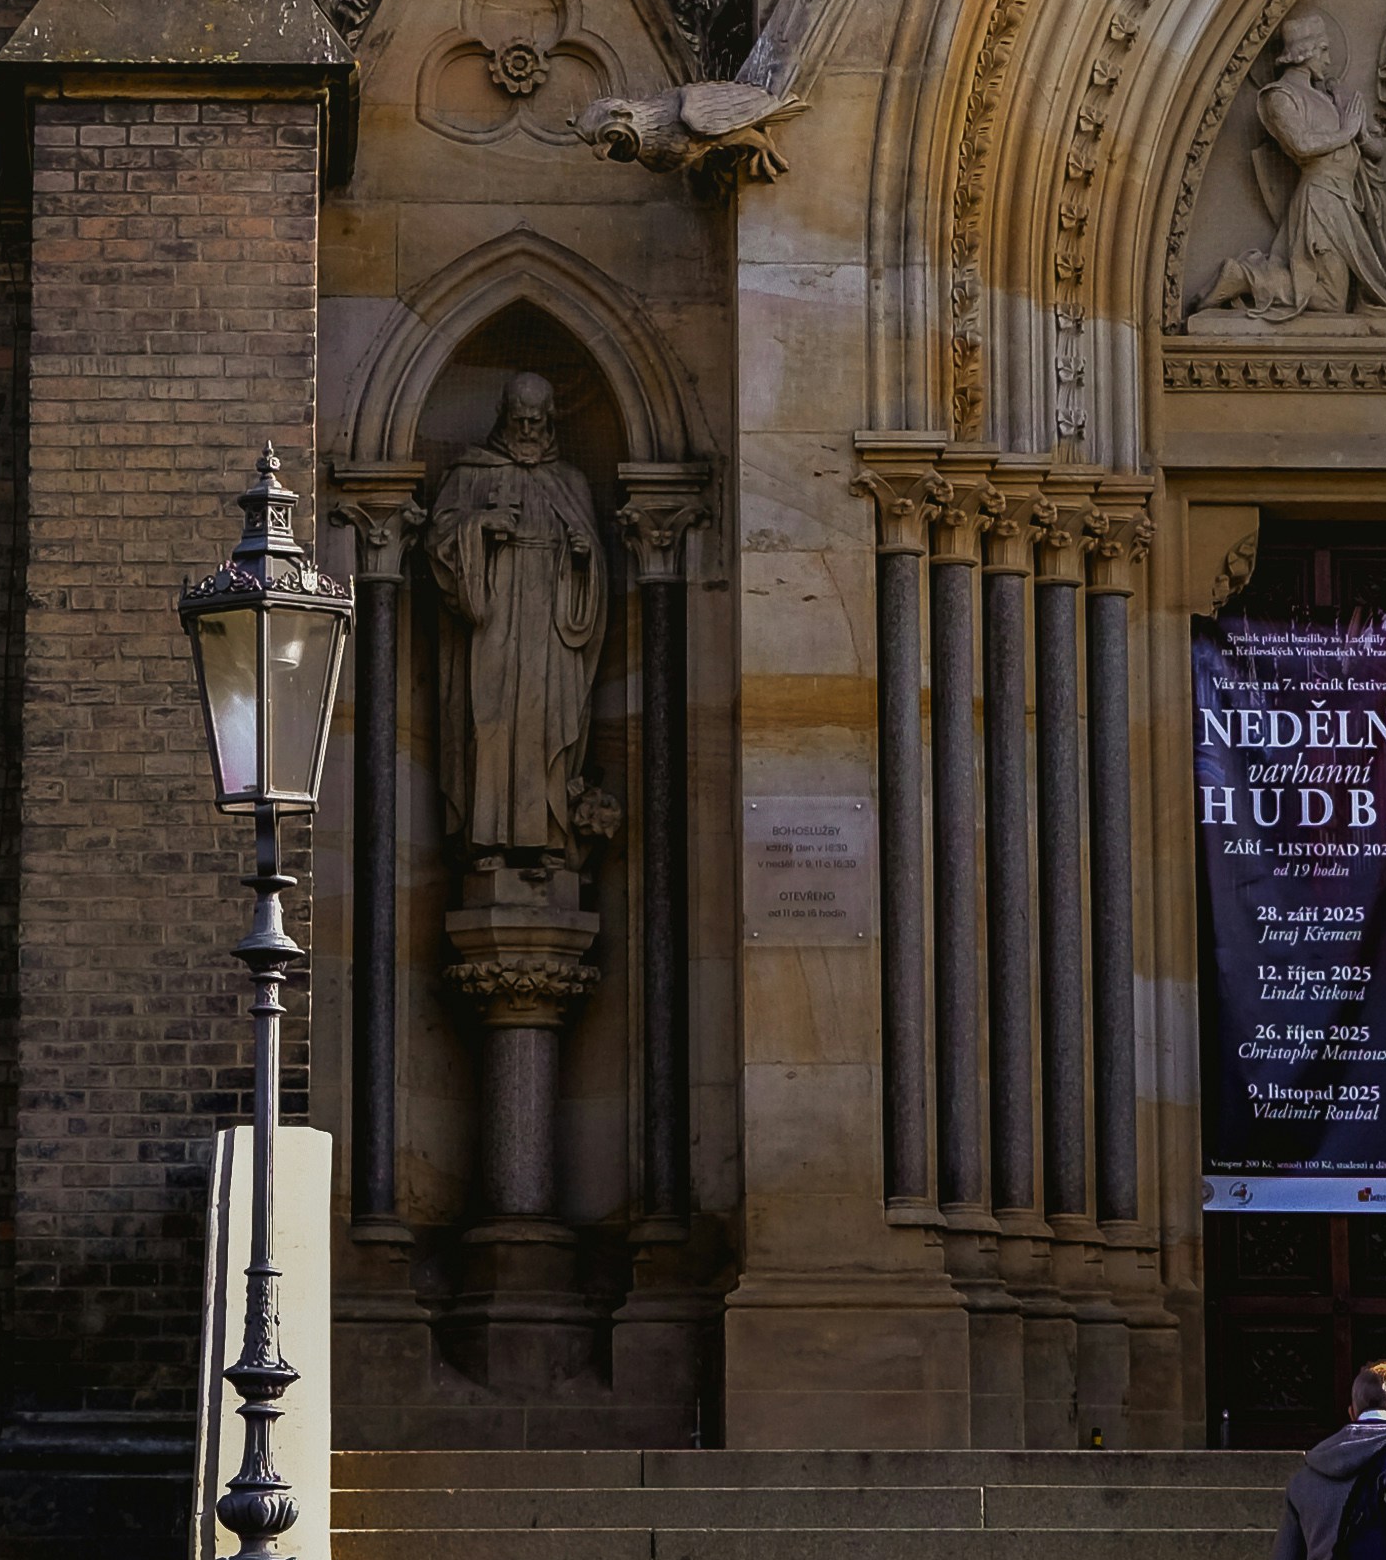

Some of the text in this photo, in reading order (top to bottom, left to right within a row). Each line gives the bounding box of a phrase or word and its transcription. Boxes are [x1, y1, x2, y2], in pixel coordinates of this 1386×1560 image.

[1227, 632, 1260, 645] Spolek
[1262, 632, 1289, 646] přátel
[1221, 648, 1233, 656] na
[1236, 645, 1294, 658] Královských
[1295, 646, 1357, 657] Vinohradech
[1358, 649, 1364, 657] v
[1213, 677, 1235, 690] Vás
[1238, 680, 1259, 690] zve
[1263, 681, 1280, 691] na
[1283, 678, 1296, 691] 7.
[1300, 678, 1344, 692] ročník
[1248, 752, 1375, 784] varhanní
[772, 824, 841, 836] BOHOSLUŽBY
[795, 843, 815, 852] den
[1223, 838, 1262, 856] ZÁŘÍ
[1278, 842, 1360, 857] LISTOPAD
[1273, 862, 1350, 877] od 19 hodin
[778, 890, 836, 901] OTEVŘENO
[767, 908, 781, 918] od
[791, 908, 805, 918] do
[819, 908, 847, 918] hodin
[1256, 905, 1365, 923] 28. září 2025
[1258, 925, 1362, 946] Juraj Křemen
[1257, 964, 1372, 985] 12. říjen 2025
[1260, 983, 1366, 1001] Linda Sítková
[1255, 1024, 1370, 1045] 26. říjen 2025
[1238, 1042, 1318, 1064] Christophe
[1247, 1082, 1380, 1104] 9. listopad 2025
[1253, 1102, 1380, 1121] Vladimír Roubal
[1244, 1159, 1261, 1169] 200
[1304, 1160, 1320, 1169] 100
